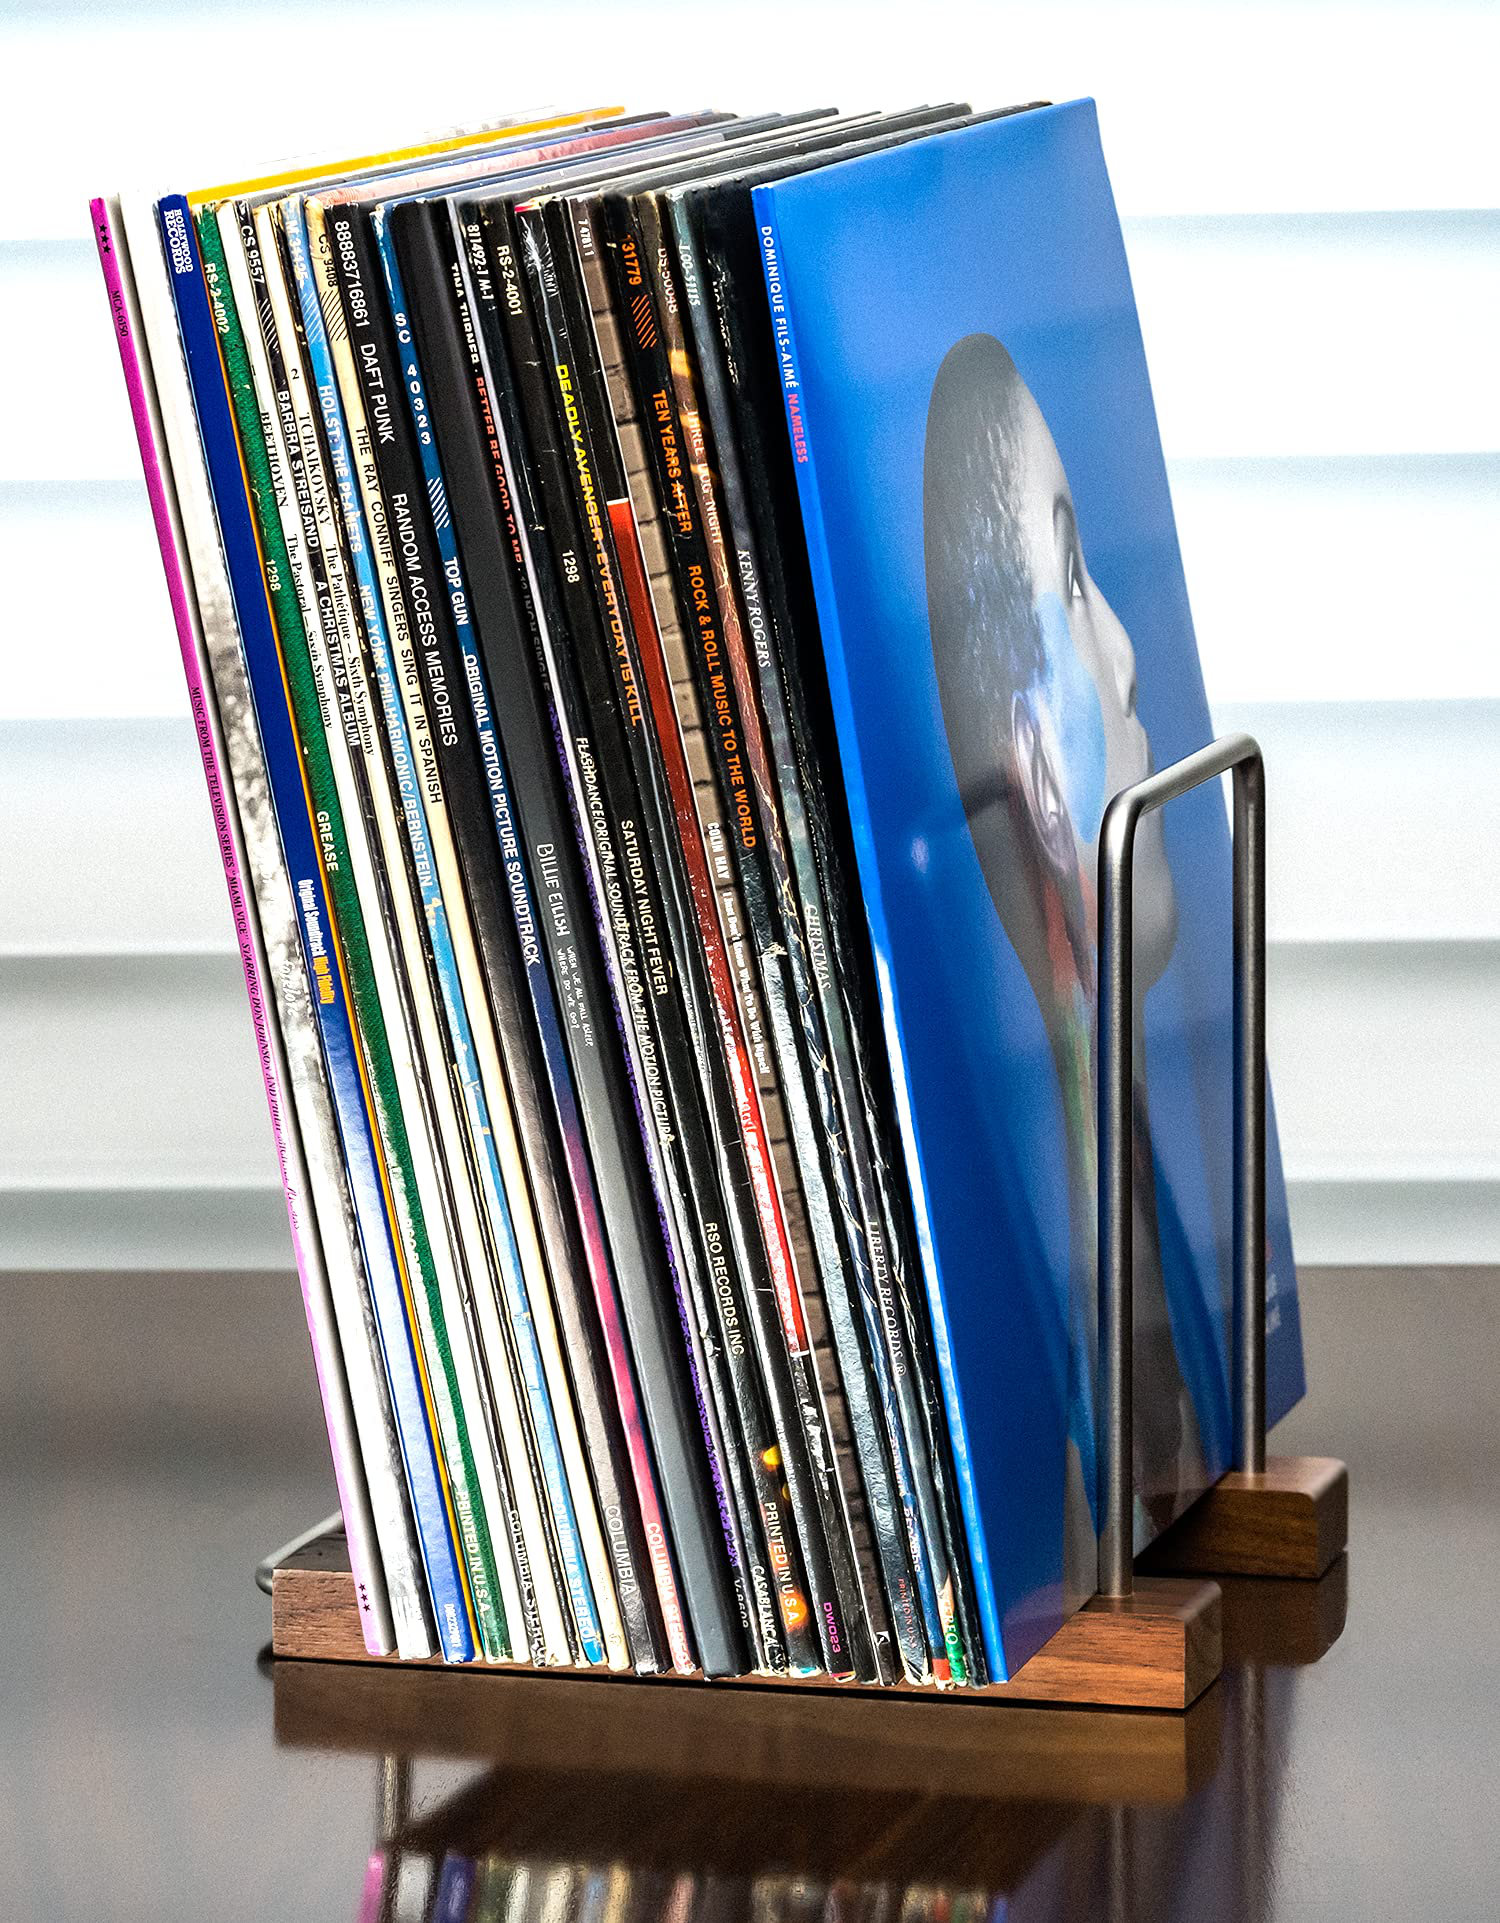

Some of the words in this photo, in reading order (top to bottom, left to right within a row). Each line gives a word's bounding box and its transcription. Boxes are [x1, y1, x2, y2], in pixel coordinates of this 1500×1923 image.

[162, 210, 186, 273] RECORDS
[173, 209, 193, 271] HOLLYWOOD
[239, 225, 256, 247] CS
[317, 234, 329, 253] CS
[245, 249, 264, 283] 9557
[322, 258, 336, 287] 9408
[334, 221, 369, 327] 88883716861
[466, 225, 487, 274] 811492-1
[477, 279, 492, 299] M-1
[496, 246, 521, 315] RS-2-4001
[760, 226, 784, 312] DOMINIQUE
[110, 290, 129, 336] MCA-6150
[203, 263, 229, 333] RS-2-4002
[359, 344, 382, 389] DAFT
[774, 318, 799, 387] FILS-AIMÉ
[318, 385, 341, 442] HOLST:
[370, 394, 394, 443] PUNK
[404, 363, 432, 443] 40323
[555, 365, 583, 442] DEADLY
[651, 390, 671, 422] TEN
[354, 426, 371, 454] THE
[686, 411, 705, 456] THREE
[786, 393, 808, 463] NAMELESS
[260, 412, 288, 506] BEETHOVEN
[277, 391, 300, 453] BARBRA
[290, 460, 319, 546] STREISAND
[297, 411, 331, 525] TCHAIKOVSKY
[331, 448, 348, 476] THE
[658, 425, 682, 477] YEARS
[362, 464, 379, 492] RAY
[572, 447, 604, 540] AVENGER
[697, 463, 712, 494] DOG
[338, 482, 364, 552] PLANETS
[669, 481, 692, 531] AFTER
[704, 500, 721, 543] NIGHT
[285, 534, 301, 559] The
[370, 501, 394, 566] CONNIFF
[391, 494, 421, 570] RANDOM
[264, 559, 281, 591] 1298
[324, 544, 340, 568] The
[442, 557, 461, 587] TOP
[561, 550, 579, 583] 1298
[736, 550, 759, 603] KENNY
[291, 562, 311, 611] Pastoral
[315, 581, 327, 591] A
[328, 574, 354, 639] Pathétique
[359, 585, 378, 619] NEW
[450, 591, 469, 625] GUN
[595, 553, 628, 656] EVERYDAY
[687, 566, 709, 610] ROCK
[385, 577, 409, 641] SINGERS
[408, 576, 437, 646] ACCESS
[697, 615, 712, 625] &
[318, 597, 347, 687] CHRISTMAS
[367, 626, 388, 669] YORK
[700, 630, 721, 671] ROLL
[747, 607, 770, 667] ROGERS
[346, 657, 363, 688] Sixth
[399, 649, 417, 684] SING
[618, 662, 633, 681] IS
[190, 686, 205, 718] MUSIC
[312, 665, 334, 728] Symphony
[408, 693, 422, 706] IT
[423, 651, 457, 745] MEMORIES
[622, 686, 643, 726] KILL
[709, 676, 732, 725] MUSIC
[196, 720, 210, 746] FROM
[338, 693, 359, 745] ALBUM
[351, 691, 377, 755] Symphony
[412, 715, 427, 729] IN
[720, 729, 737, 750] TO
[202, 750, 214, 770] THE
[377, 673, 433, 886] PHILHARMONIC/BERNSTEIN
[417, 739, 441, 803] SPANISH
[725, 755, 744, 784] THE
[207, 772, 226, 831] TELEVISION
[462, 654, 490, 727] ORIGINAL
[478, 730, 503, 789] MOTION
[492, 794, 518, 859] PICTURE
[506, 862, 540, 966] SOUNDTRACK
[576, 737, 616, 879] FLASHDANCE/ORIGINAL
[732, 789, 756, 847] WORLD
[219, 834, 233, 867] SERIES
[315, 811, 339, 871] GREASE
[620, 820, 647, 894] SATURDAY
[706, 822, 724, 852] COLIN
[535, 843, 561, 887] BILLIE
[713, 856, 729, 879] HAY
[295, 879, 318, 910] Original
[545, 893, 571, 936] EILISH
[723, 898, 736, 915] Just
[303, 911, 327, 956] Soundtrack
[606, 882, 634, 965] SOUNDTRACK
[636, 898, 657, 943] NIGHT
[727, 917, 741, 940] Don't
[240, 943, 258, 994] STARRING
[310, 956, 330, 973] High
[556, 948, 569, 975] WHERE
[566, 946, 577, 968] WHEN
[732, 942, 747, 967] Know
[804, 904, 831, 989] CHRISTMAS
[314, 975, 336, 1004] Fidelity
[562, 979, 572, 990] DO
[571, 972, 581, 985] WE
[574, 987, 584, 999] ALL
[624, 969, 642, 1003] FROM
[646, 948, 667, 995] FEVER
[737, 968, 752, 992] What
[251, 997, 263, 1020] DON
[564, 993, 575, 1007] WE
[568, 1012, 579, 1028] GO?
[576, 1002, 588, 1019] FALL
[632, 1006, 648, 1030] THE
[743, 994, 755, 1005] To
[746, 1008, 758, 1019] Do
[748, 1020, 762, 1042] With
[638, 1034, 659, 1085] MOTION
[751, 1043, 769, 1073] Myself
[704, 1222, 722, 1252] RSO
[711, 1256, 738, 1326] RECORDS
[867, 1221, 888, 1283] LIBERTY
[880, 1287, 902, 1356] RECORDS
[727, 1329, 744, 1358] INC.
[456, 1491, 478, 1553] PRINTED
[468, 1557, 482, 1571] IN
[604, 1505, 636, 1596] COLUMBIA
[763, 1502, 787, 1564] PRINTED
[646, 1523, 674, 1601] COLUMBIA
[776, 1566, 790, 1581] IN
[569, 1577, 594, 1636] STEREO
[752, 1565, 777, 1644] CASABLANCA
[780, 1584, 799, 1624] U.S.A.
